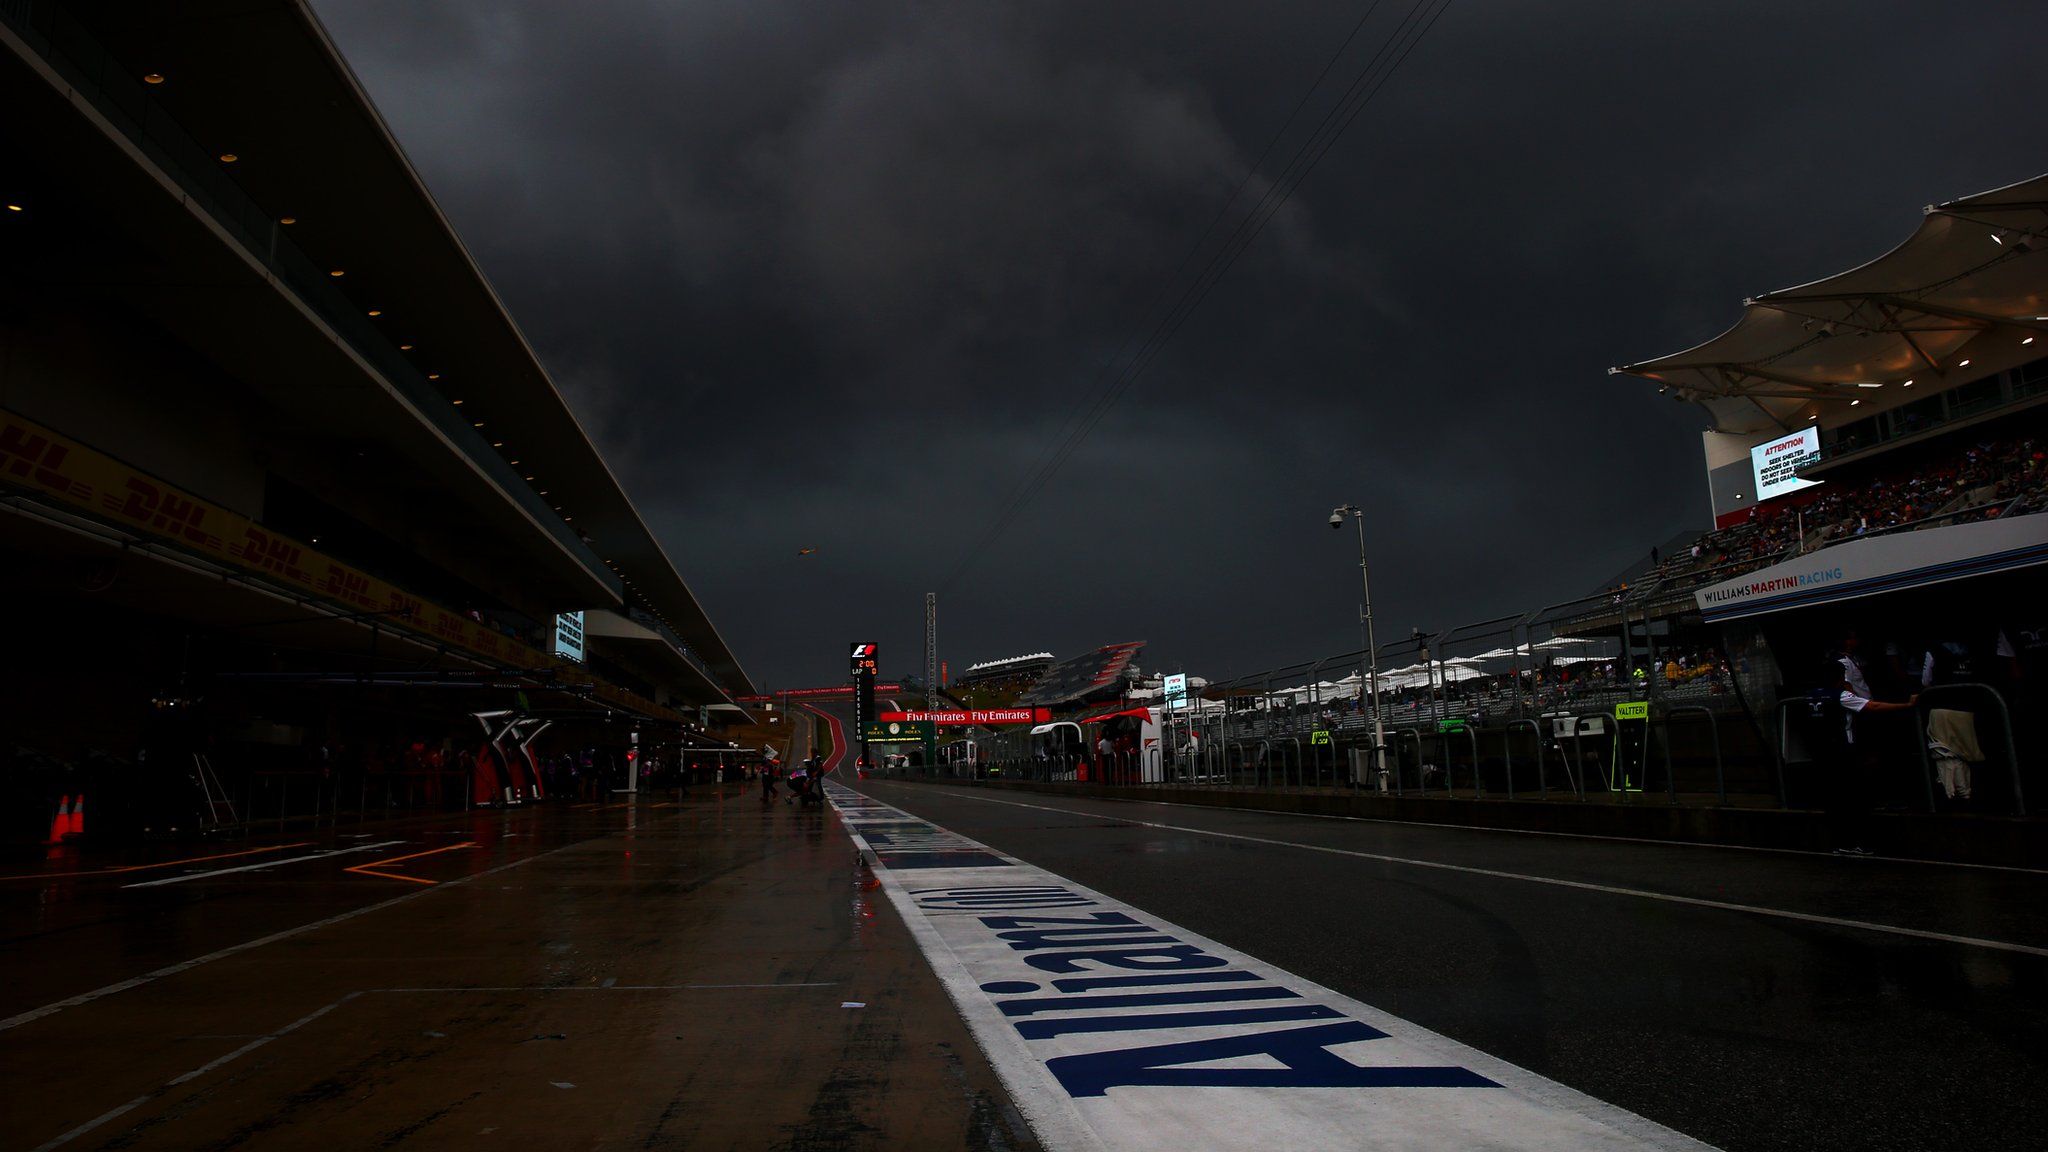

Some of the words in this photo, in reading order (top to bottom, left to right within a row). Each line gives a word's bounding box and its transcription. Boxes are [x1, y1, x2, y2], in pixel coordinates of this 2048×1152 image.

[1765, 437, 1804, 456] ATTENTION
[1782, 449, 1804, 461] SHELTER
[1760, 463, 1782, 475] INDOORS
[1769, 470, 1779, 479] NOT
[1762, 477, 1779, 487] UNDER
[121, 477, 208, 545] DHL
[242, 527, 302, 582] DHL
[326, 564, 370, 605] DHL
[1704, 585, 1751, 602] WILLIAMS
[1751, 576, 1798, 594] MARTINI
[1799, 568, 1842, 586] RACING
[907, 713, 922, 721] Fly
[924, 712, 965, 721] Emirates
[972, 711, 988, 722] Fly
[989, 710, 1030, 721] Emirates
[1618, 705, 1646, 715] VALTTERI
[978, 911, 1507, 1098] Allianz
